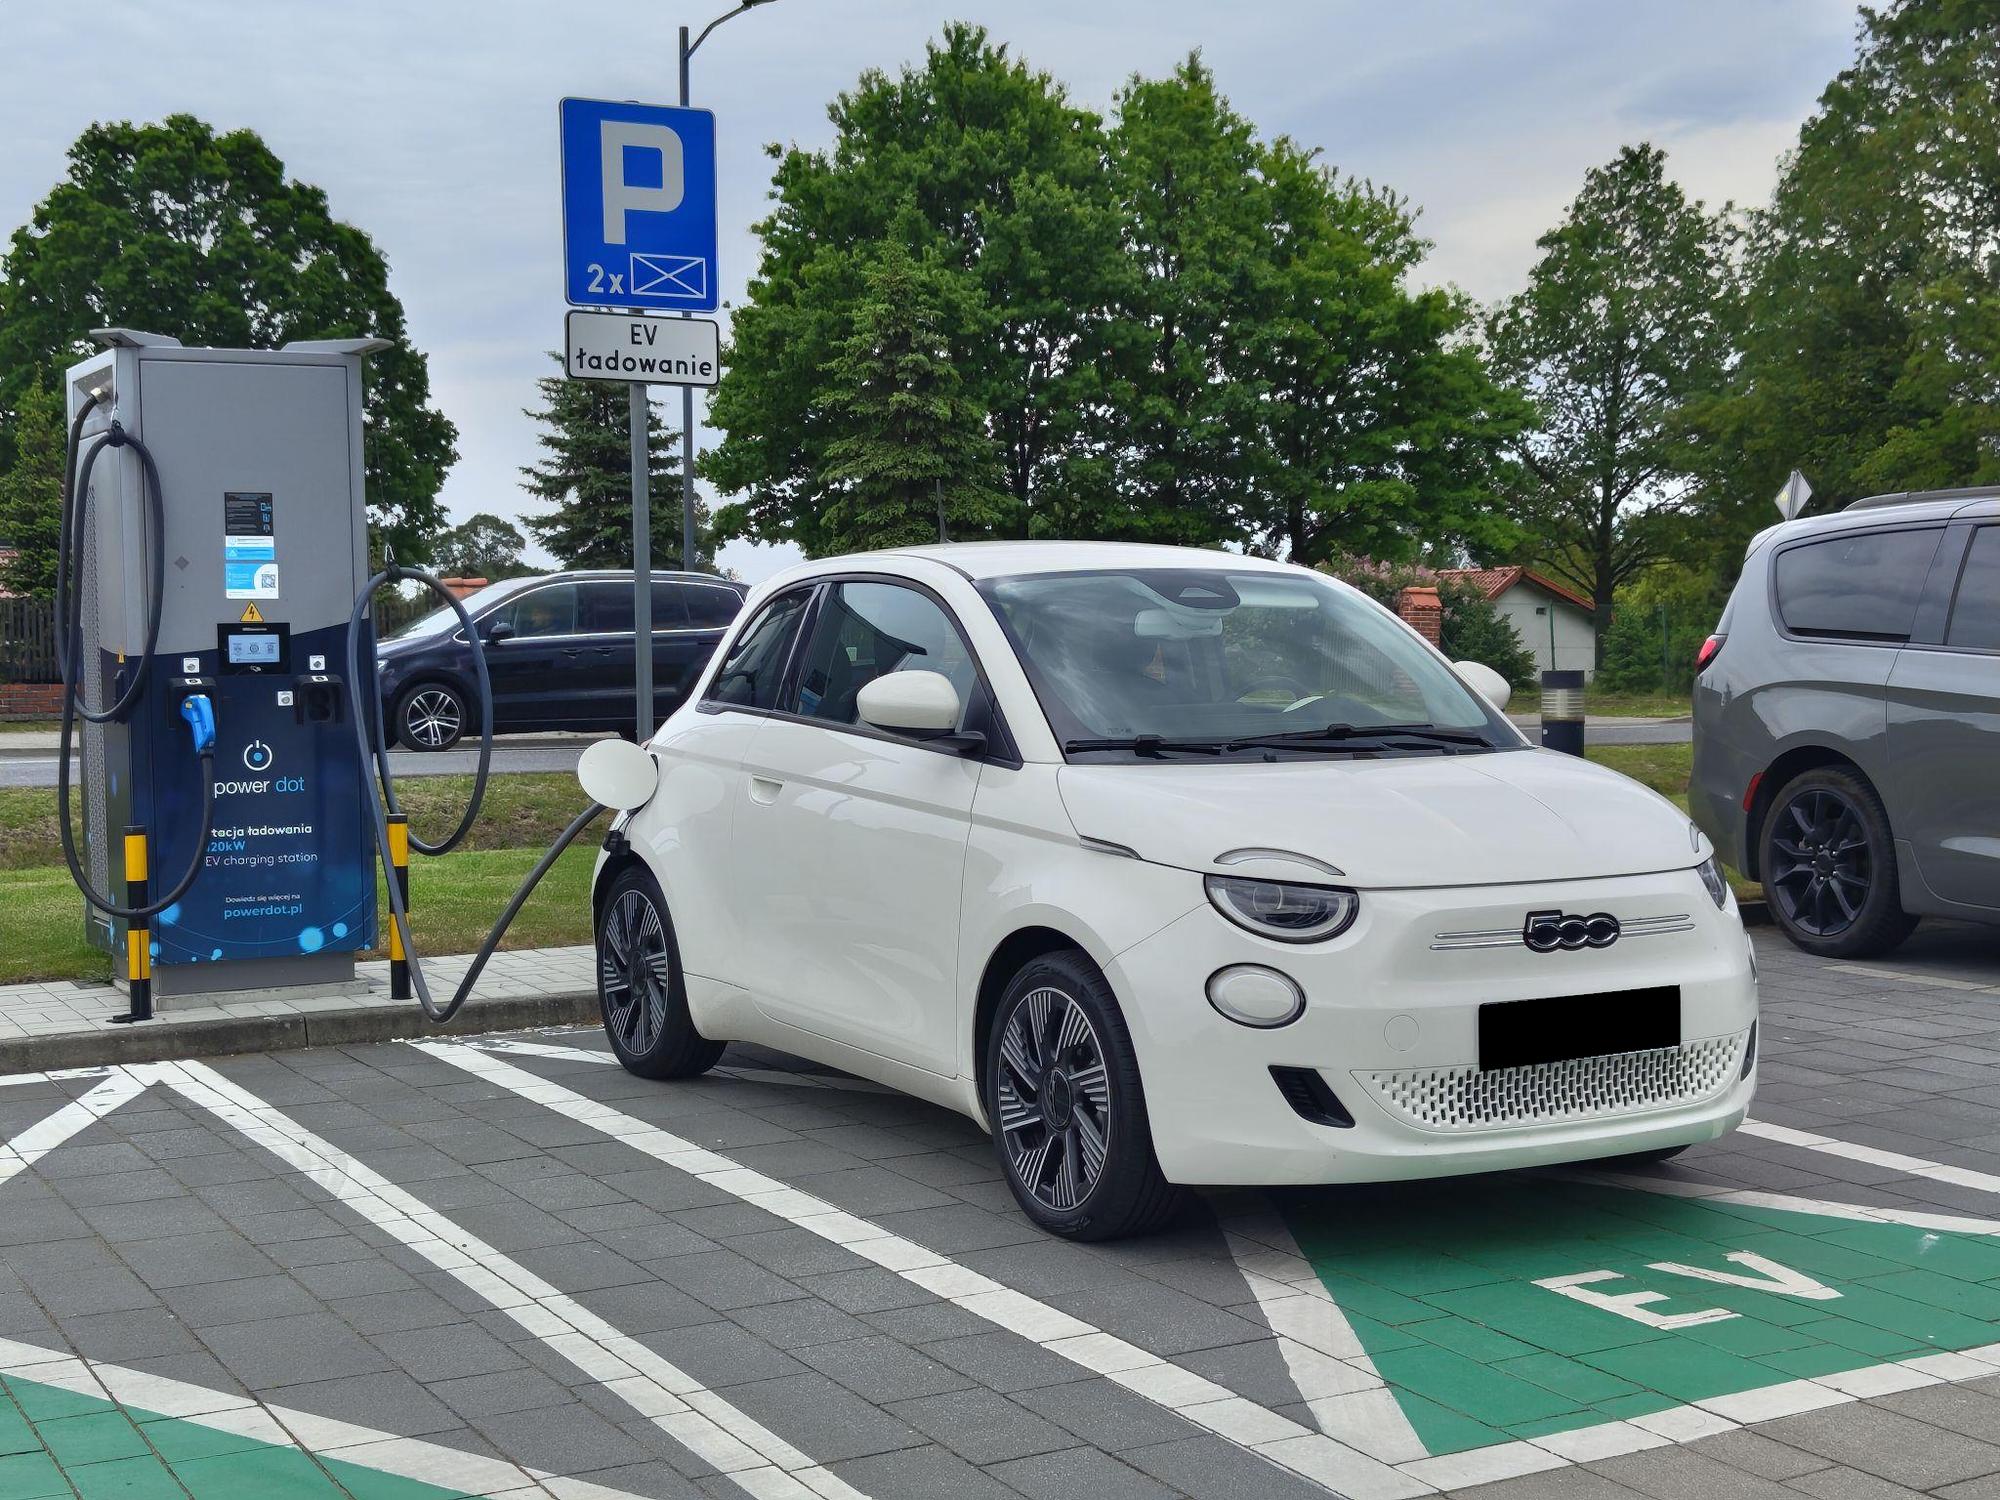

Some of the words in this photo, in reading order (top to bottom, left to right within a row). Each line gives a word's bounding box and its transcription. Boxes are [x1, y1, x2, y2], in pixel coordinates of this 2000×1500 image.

[600, 120, 685, 245] P
[630, 323, 658, 346] EV
[575, 347, 713, 377] ładowanie
[213, 780, 271, 799] power
[275, 776, 305, 793] dot
[211, 826, 245, 840] tacja
[247, 823, 313, 836] ładowania
[205, 855, 221, 867] EV
[223, 854, 275, 868] charging
[277, 852, 318, 864] station
[224, 903, 303, 920] powerdot.pl
[1523, 910, 1620, 953] 500
[1530, 1250, 1845, 1330] EV
